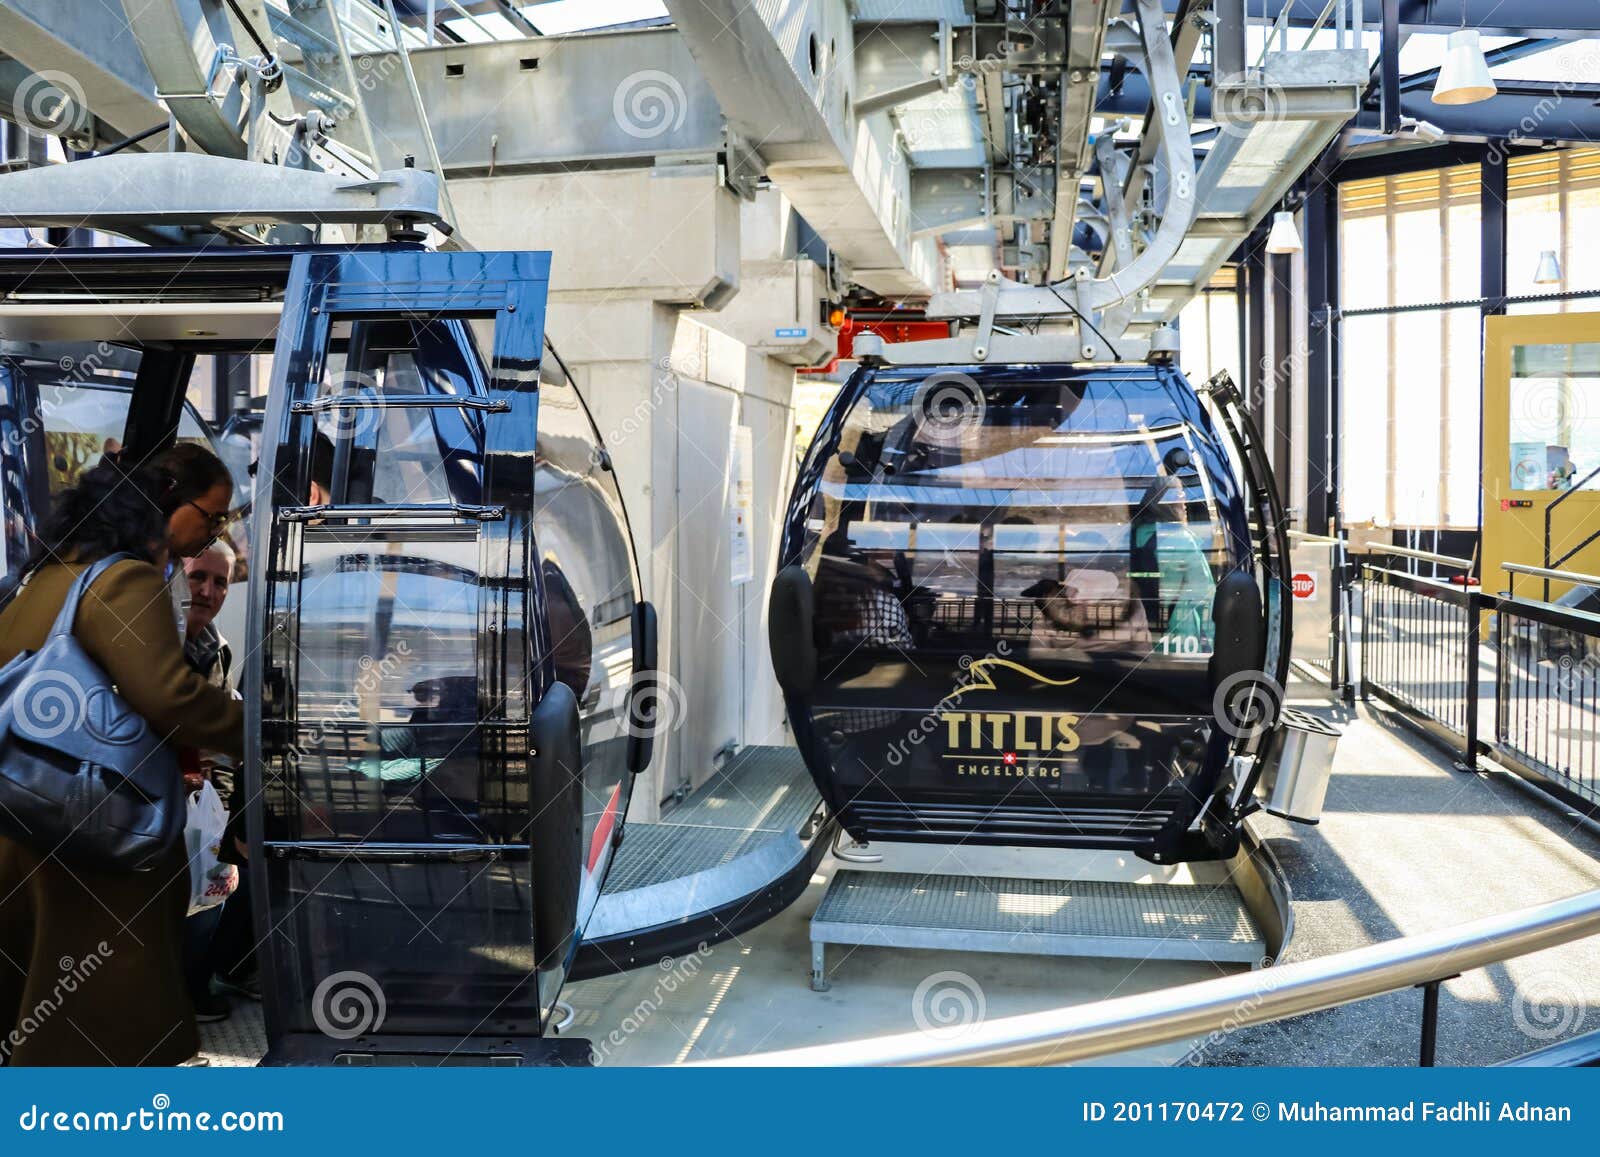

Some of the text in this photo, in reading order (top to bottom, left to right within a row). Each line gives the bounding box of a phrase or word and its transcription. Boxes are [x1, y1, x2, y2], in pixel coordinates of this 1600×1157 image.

[1291, 580, 1313, 591] STOP
[1159, 635, 1199, 655] 110
[941, 712, 1080, 752] TITLIS
[958, 764, 1060, 778] ENGELBERG
